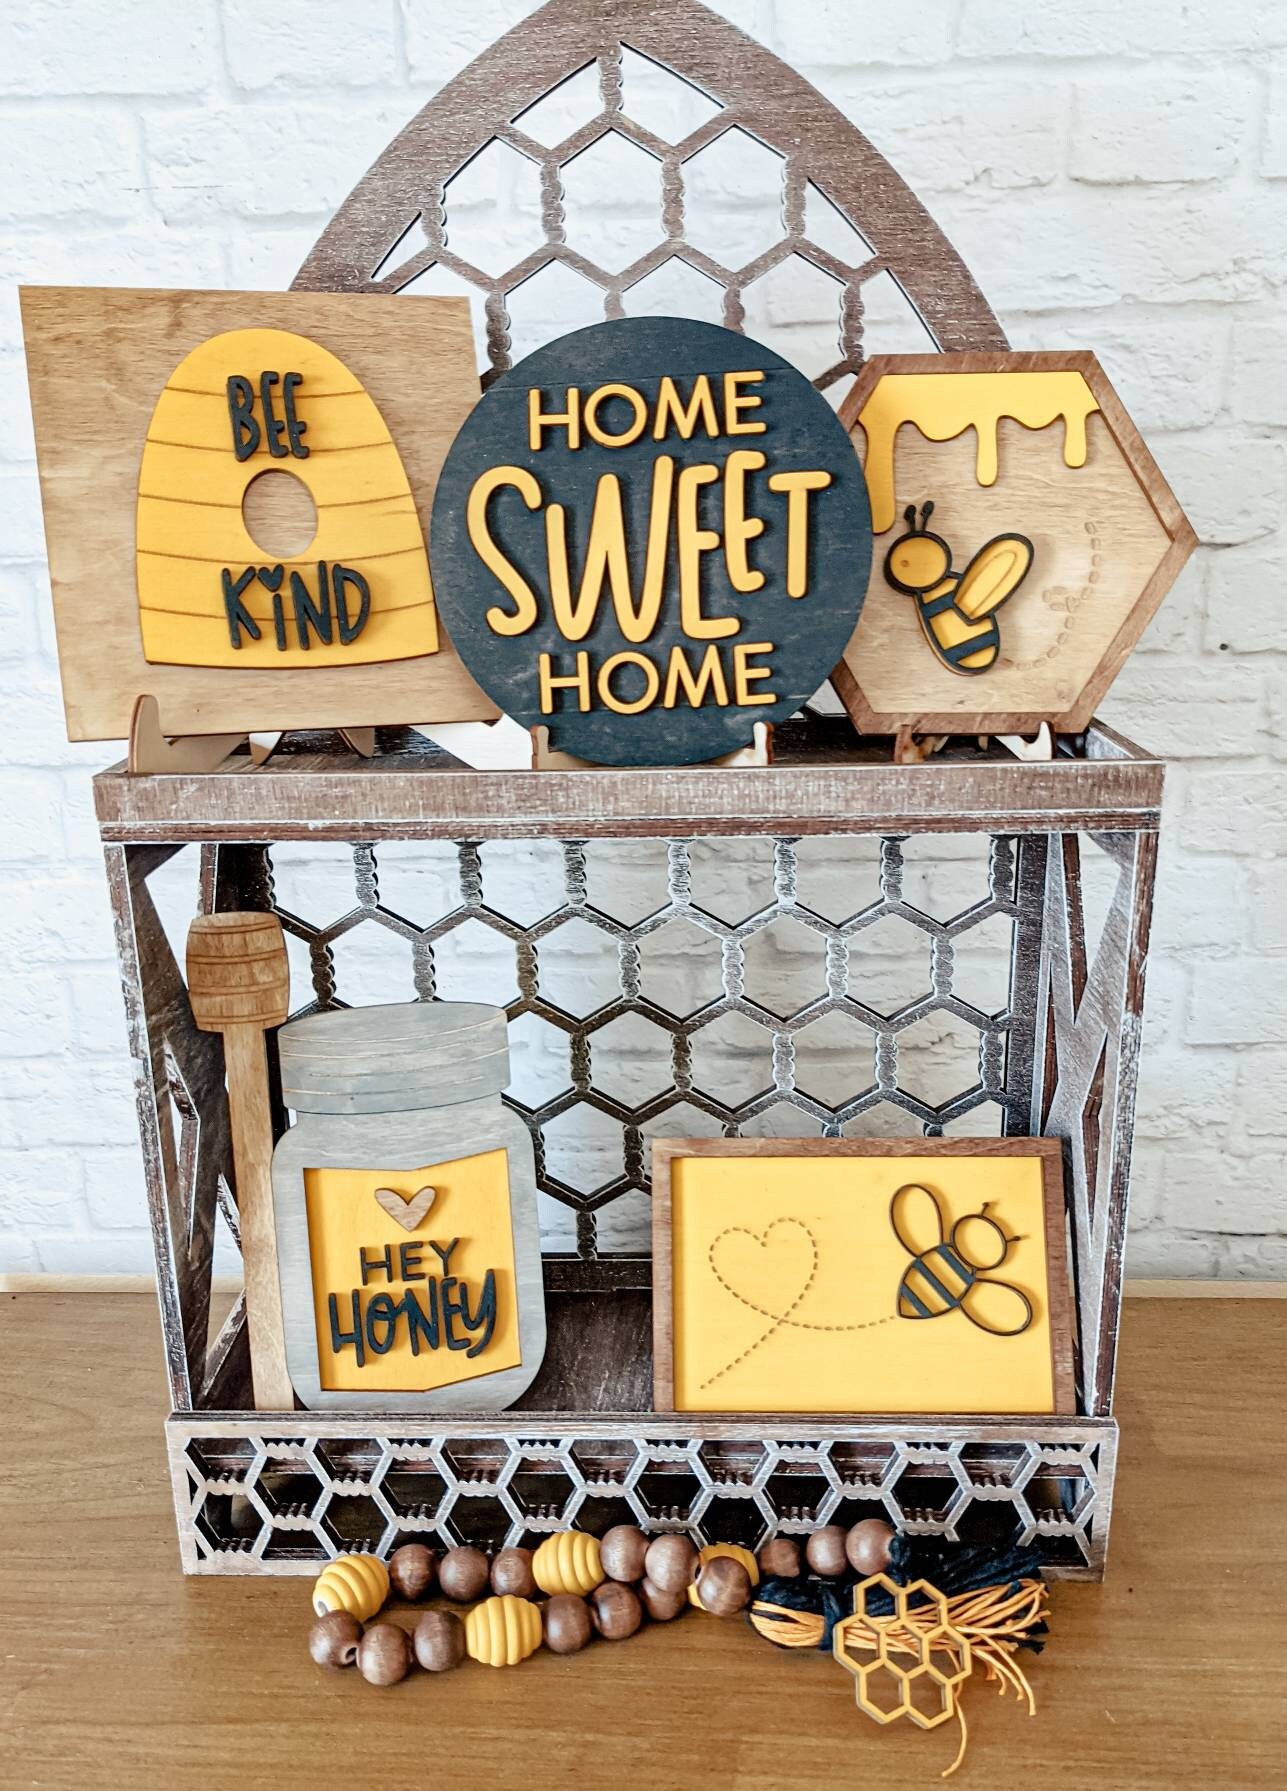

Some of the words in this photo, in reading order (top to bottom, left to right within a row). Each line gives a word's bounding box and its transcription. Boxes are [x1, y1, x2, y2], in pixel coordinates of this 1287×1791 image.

[226, 371, 311, 462] BEE
[527, 370, 767, 452] HOME
[466, 449, 833, 643] SWEET
[538, 642, 778, 715] HOME
[359, 1237, 460, 1286] HEY
